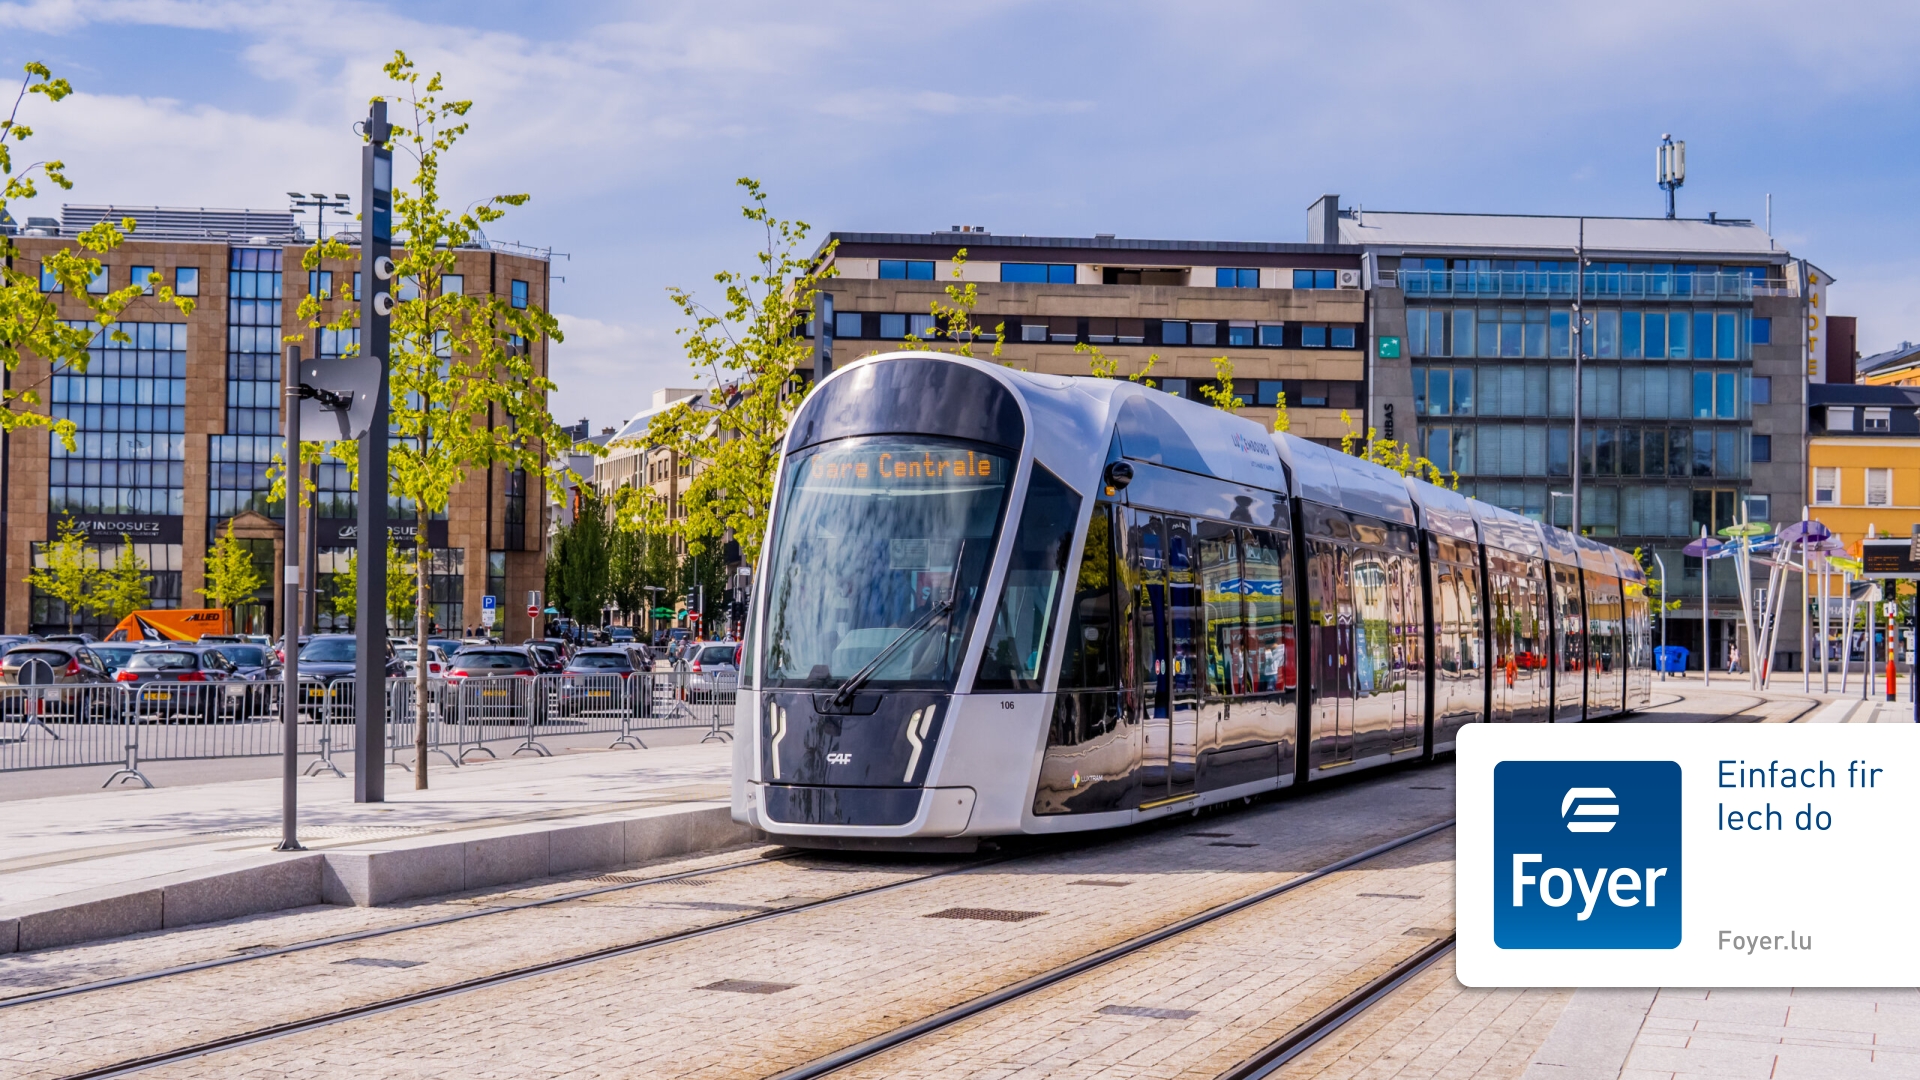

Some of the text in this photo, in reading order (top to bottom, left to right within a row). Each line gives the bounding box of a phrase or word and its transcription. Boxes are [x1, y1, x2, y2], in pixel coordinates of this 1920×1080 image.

[811, 450, 991, 479] Gare Centrale
[93, 521, 159, 531] INDOSUEZ
[486, 598, 493, 608] P
[185, 613, 220, 621] ALLIED
[1000, 701, 1015, 710] 106
[827, 753, 852, 765] CAF
[1081, 774, 1103, 782] LUXTRAM
